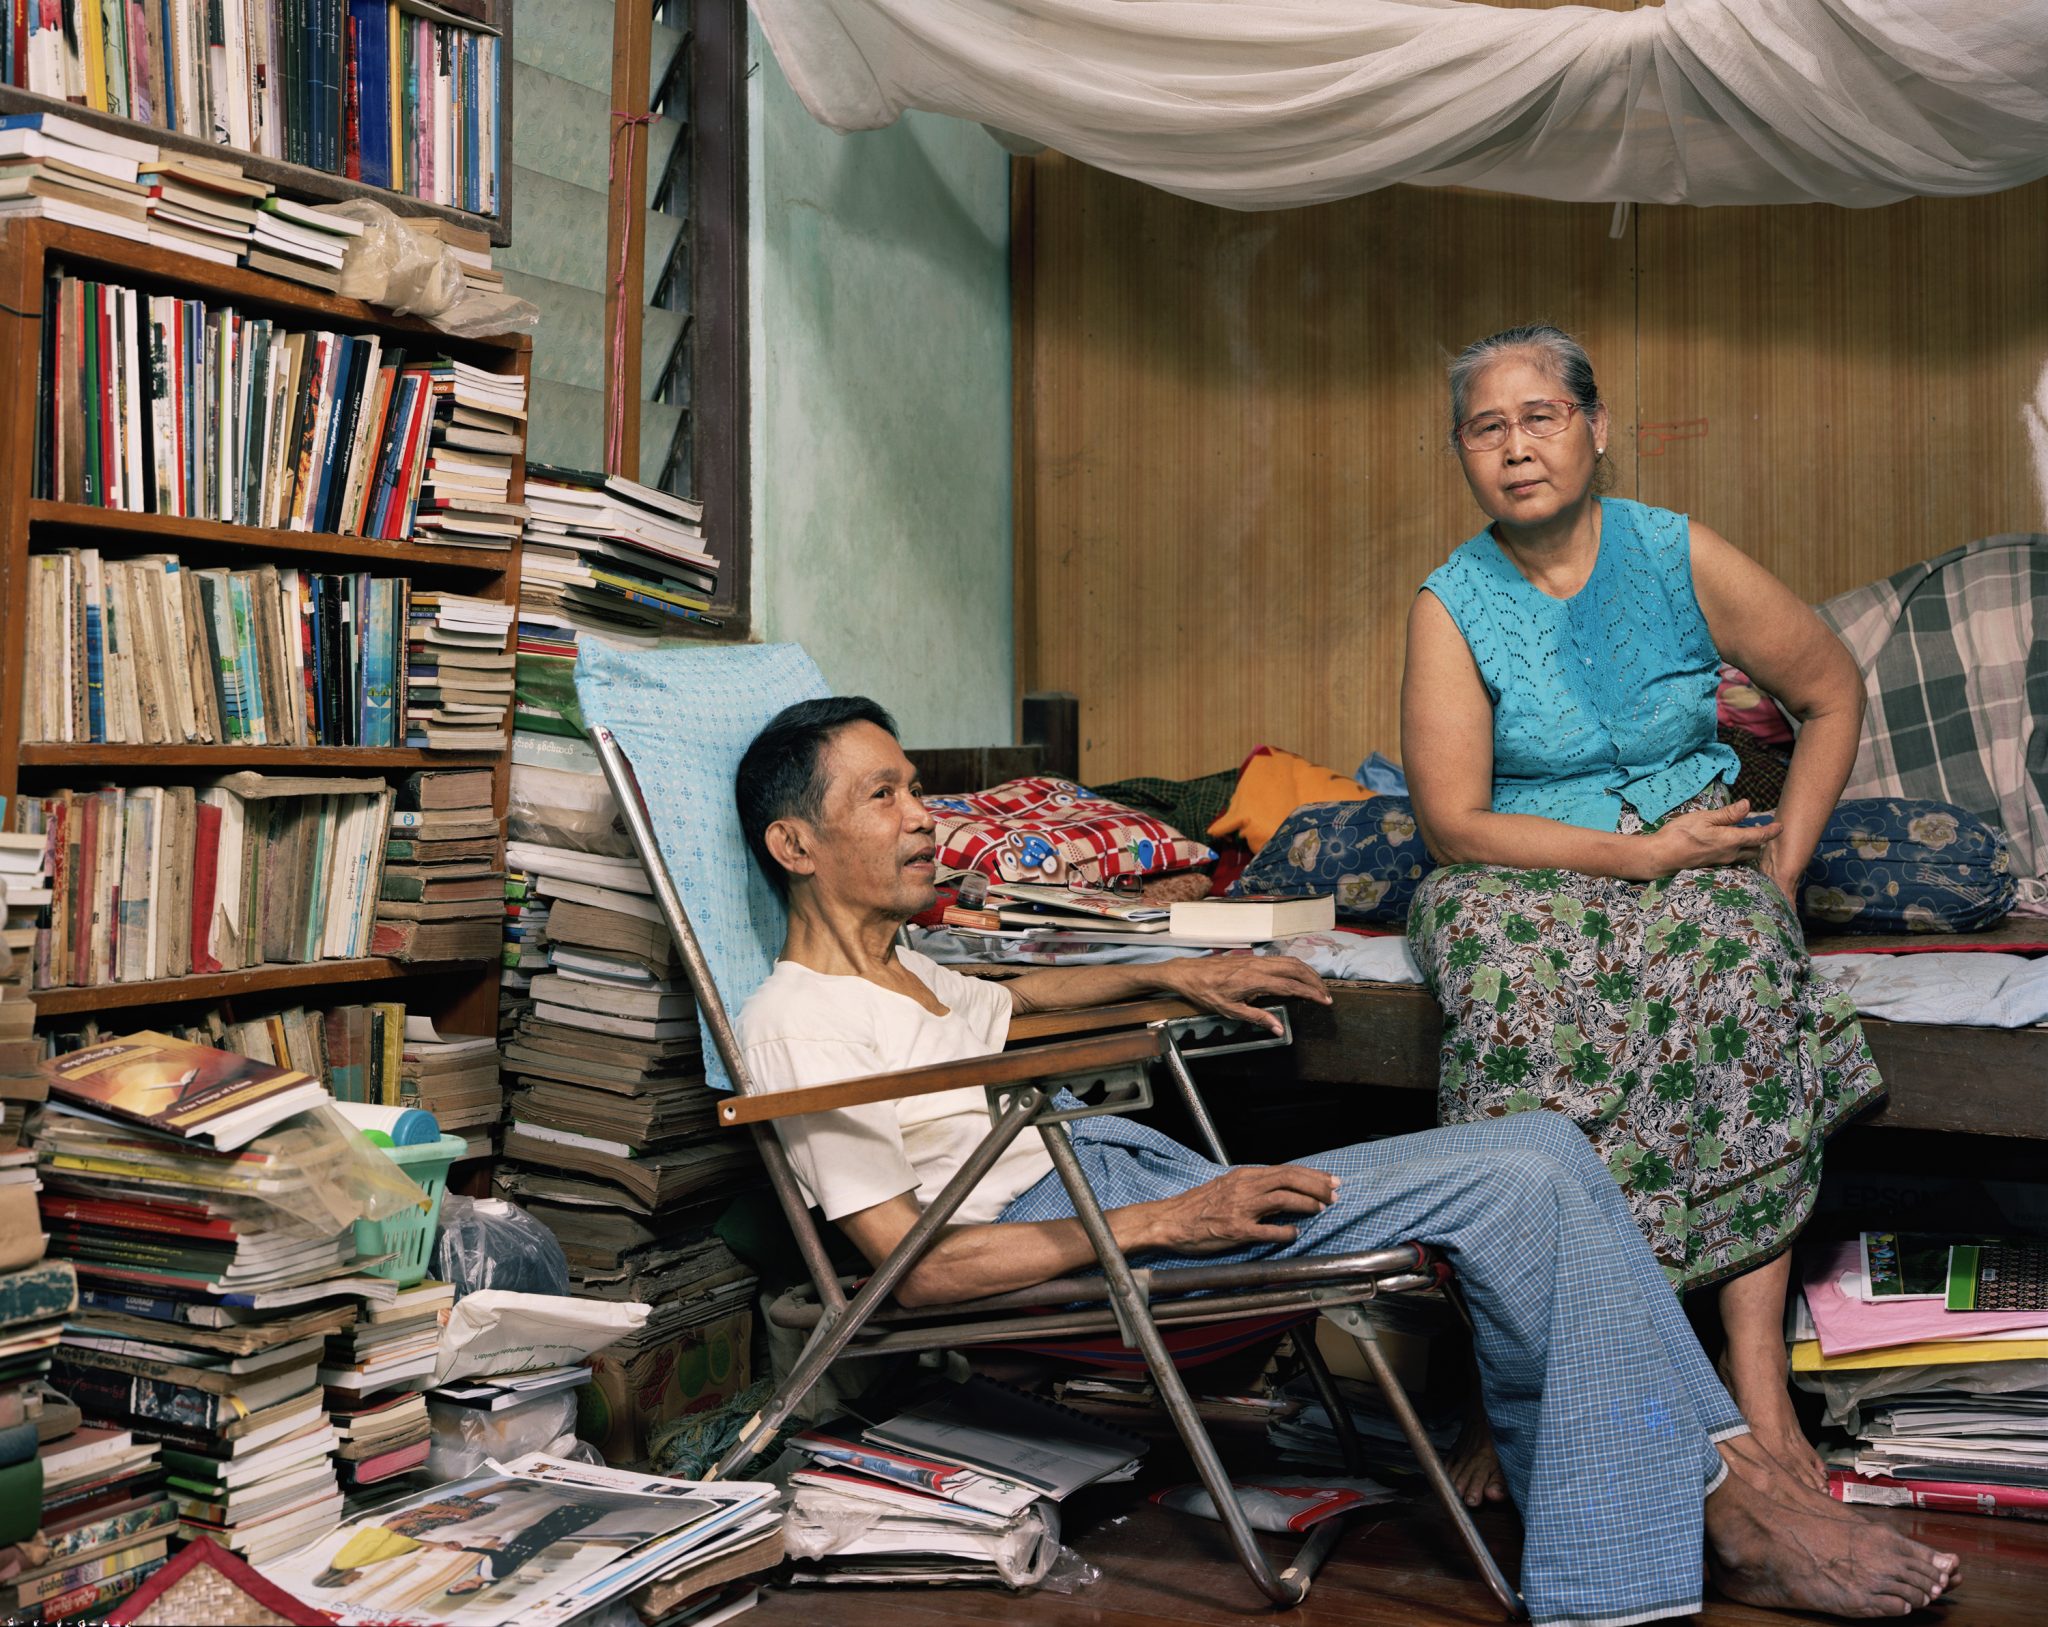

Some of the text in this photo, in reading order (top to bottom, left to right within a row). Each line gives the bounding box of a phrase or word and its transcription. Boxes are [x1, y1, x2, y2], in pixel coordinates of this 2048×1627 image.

[197, 1092, 222, 1106] Image
[229, 1080, 253, 1092] Islam
[126, 1296, 155, 1308] COURAGE
